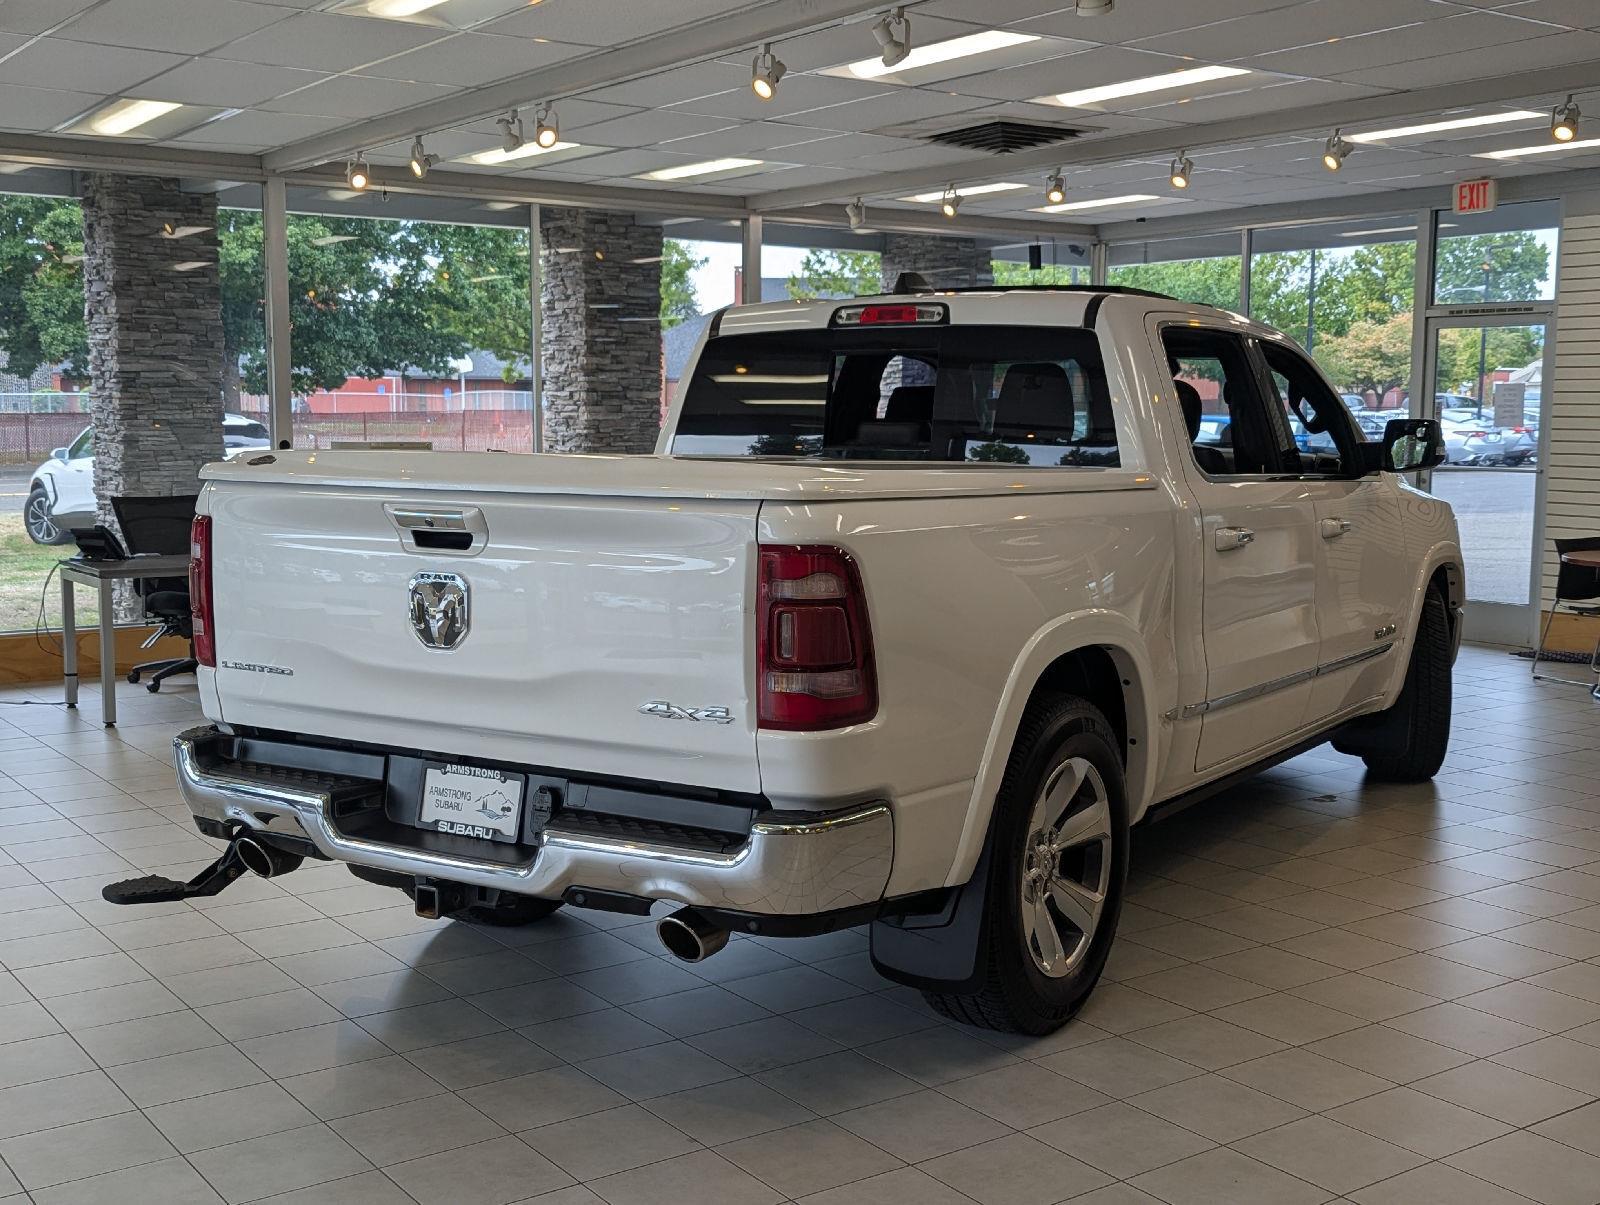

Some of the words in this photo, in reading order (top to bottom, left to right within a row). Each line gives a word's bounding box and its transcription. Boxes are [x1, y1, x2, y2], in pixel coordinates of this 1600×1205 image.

[1458, 182, 1489, 211] EXIT
[420, 573, 456, 582] RAM
[221, 660, 294, 676] LIMITED
[445, 763, 501, 780] ARMSTRONG
[429, 786, 472, 801] ARMSTRONG
[434, 799, 464, 812] SUBARU
[437, 821, 493, 840] SUBARU
